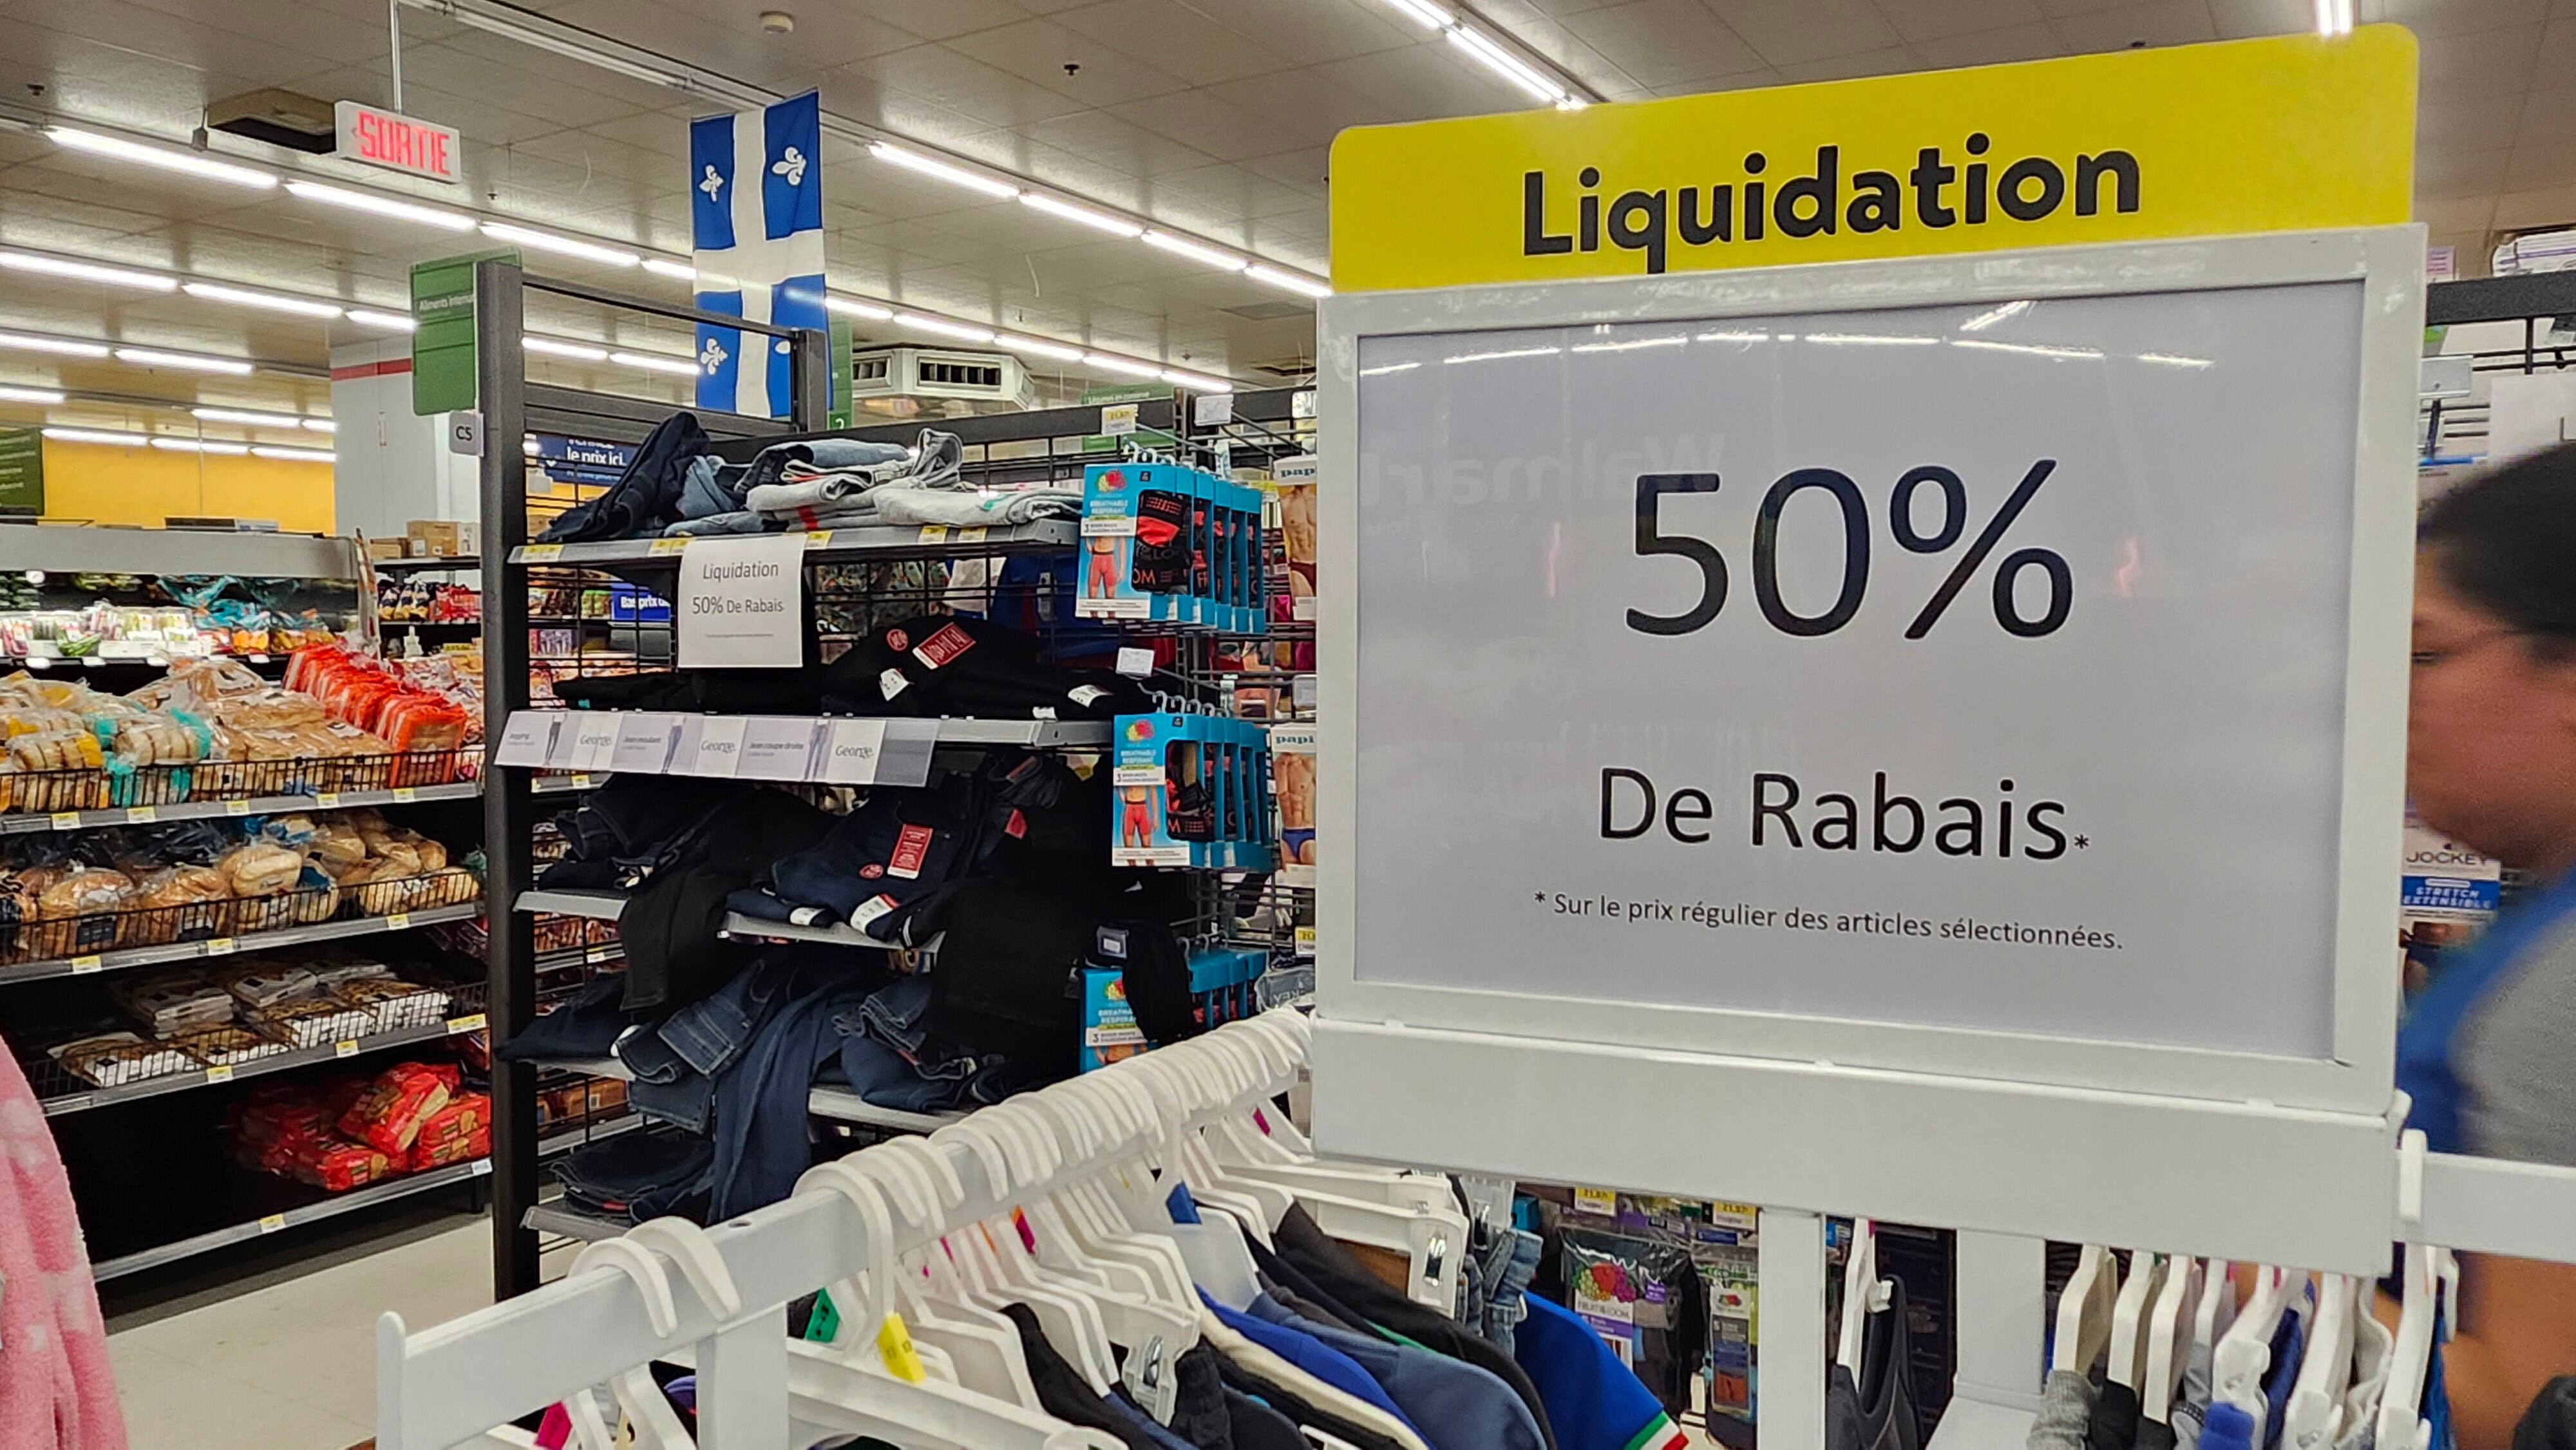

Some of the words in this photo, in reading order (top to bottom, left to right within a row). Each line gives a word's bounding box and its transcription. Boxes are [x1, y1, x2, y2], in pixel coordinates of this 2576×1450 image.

[358, 111, 451, 176] SORTIE
[1524, 133, 2139, 274] Liquidation
[455, 426, 472, 440] C5
[1281, 469, 1315, 477] pap
[1627, 460, 2072, 639] 50%
[703, 561, 779, 582] Liquidation
[692, 596, 723, 614] 50%
[727, 600, 741, 612] De
[1276, 735, 1314, 744] papi
[1601, 768, 1712, 843] De
[2406, 851, 2488, 866] JOCKEY
[2403, 895, 2492, 909] EXTENSIBLE
[2416, 887, 2479, 899] STRETCH
[1554, 894, 1593, 915] Sur
[1601, 895, 1620, 917] le
[1629, 899, 1673, 927] prix
[1682, 901, 1777, 929] régulier
[1785, 907, 1828, 930] des
[1837, 912, 1931, 937] articles
[1940, 918, 2123, 949] sélectionnées.
